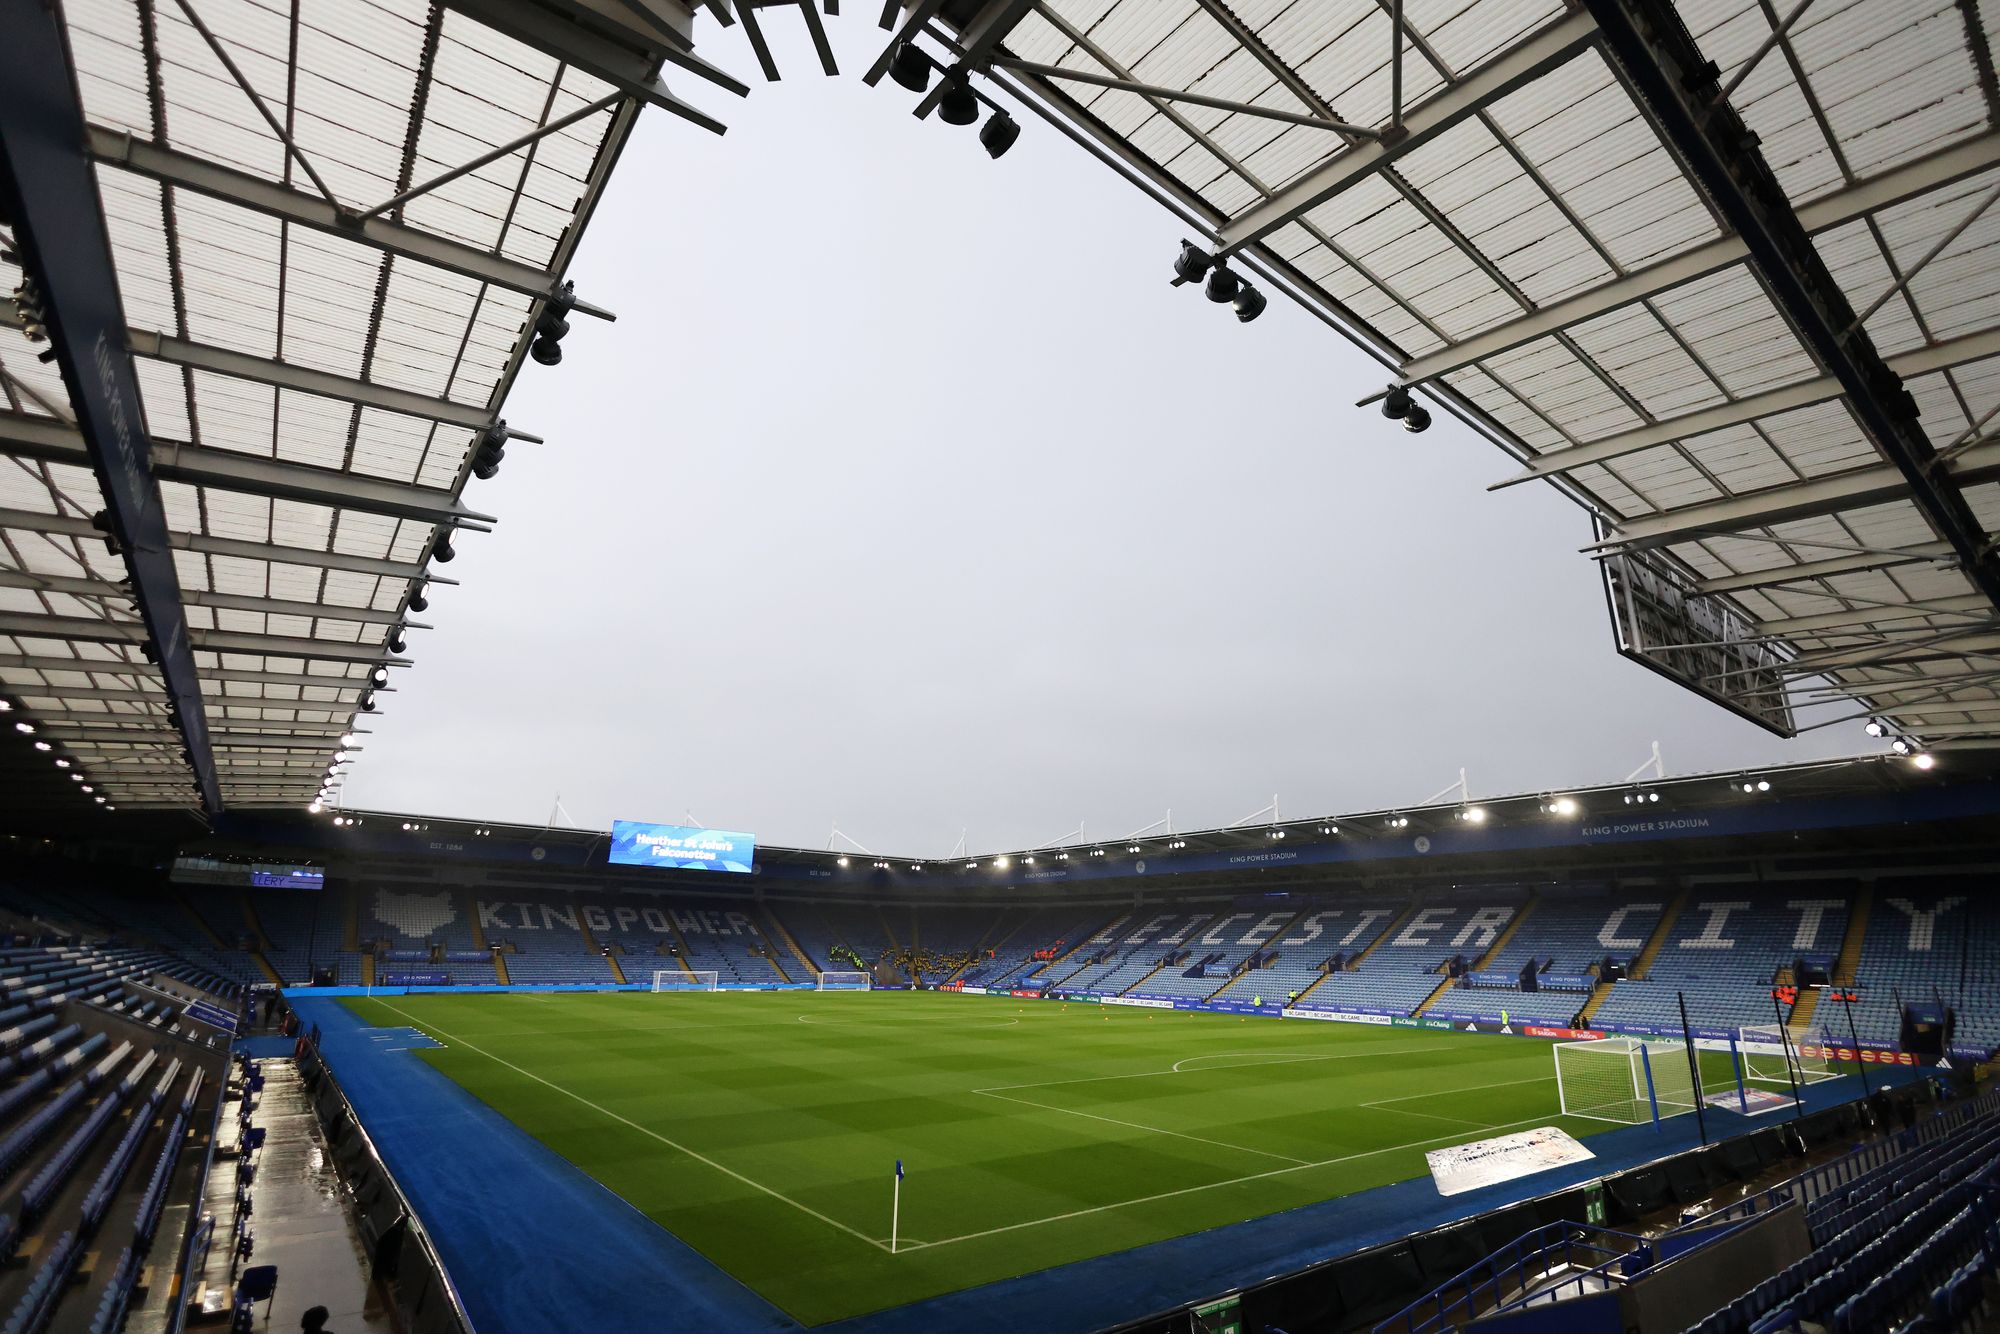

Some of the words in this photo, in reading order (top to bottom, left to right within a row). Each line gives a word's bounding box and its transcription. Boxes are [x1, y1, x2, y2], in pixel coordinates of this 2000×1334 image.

[1582, 826, 1610, 836] KING
[1614, 822, 1654, 834] POWER
[1658, 818, 1710, 830] STADIUM
[636, 833, 683, 848] Heather
[652, 846, 716, 860] Falconettes
[1246, 854, 1269, 862] POWER
[1270, 852, 1297, 860] STADIUM
[1090, 905, 1515, 947] LEICESTER
[1596, 896, 1967, 951] CITY
